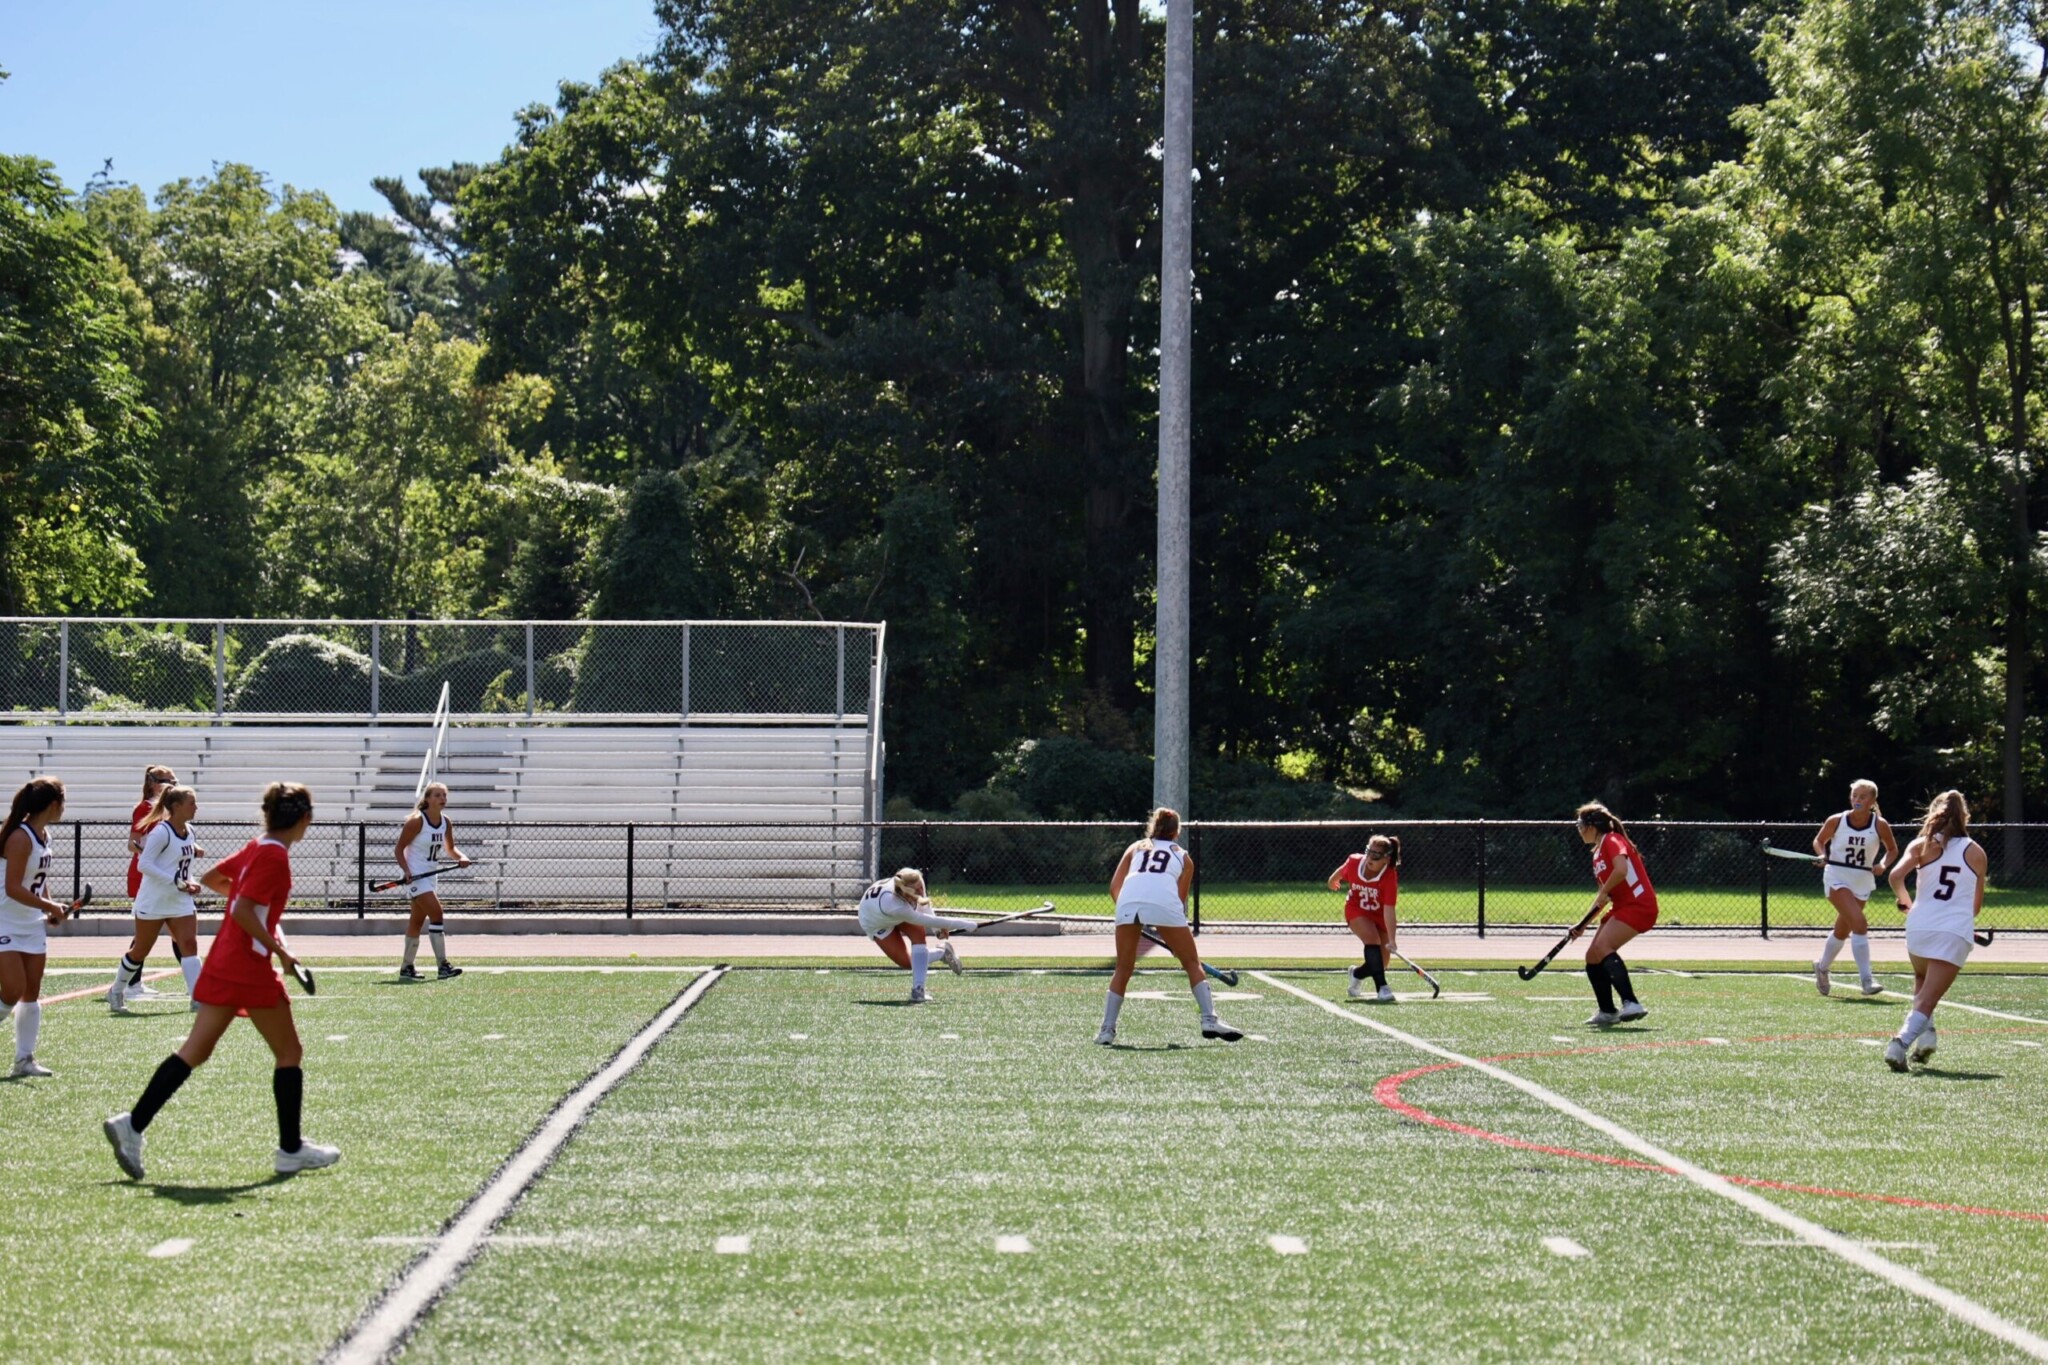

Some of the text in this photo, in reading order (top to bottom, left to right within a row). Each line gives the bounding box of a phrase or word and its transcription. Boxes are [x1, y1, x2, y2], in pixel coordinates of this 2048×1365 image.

[1848, 835, 1866, 846] RYE
[1138, 849, 1171, 873] 19
[1845, 847, 1866, 866] 24
[30, 872, 47, 898] 2
[1933, 865, 1961, 901] 5
